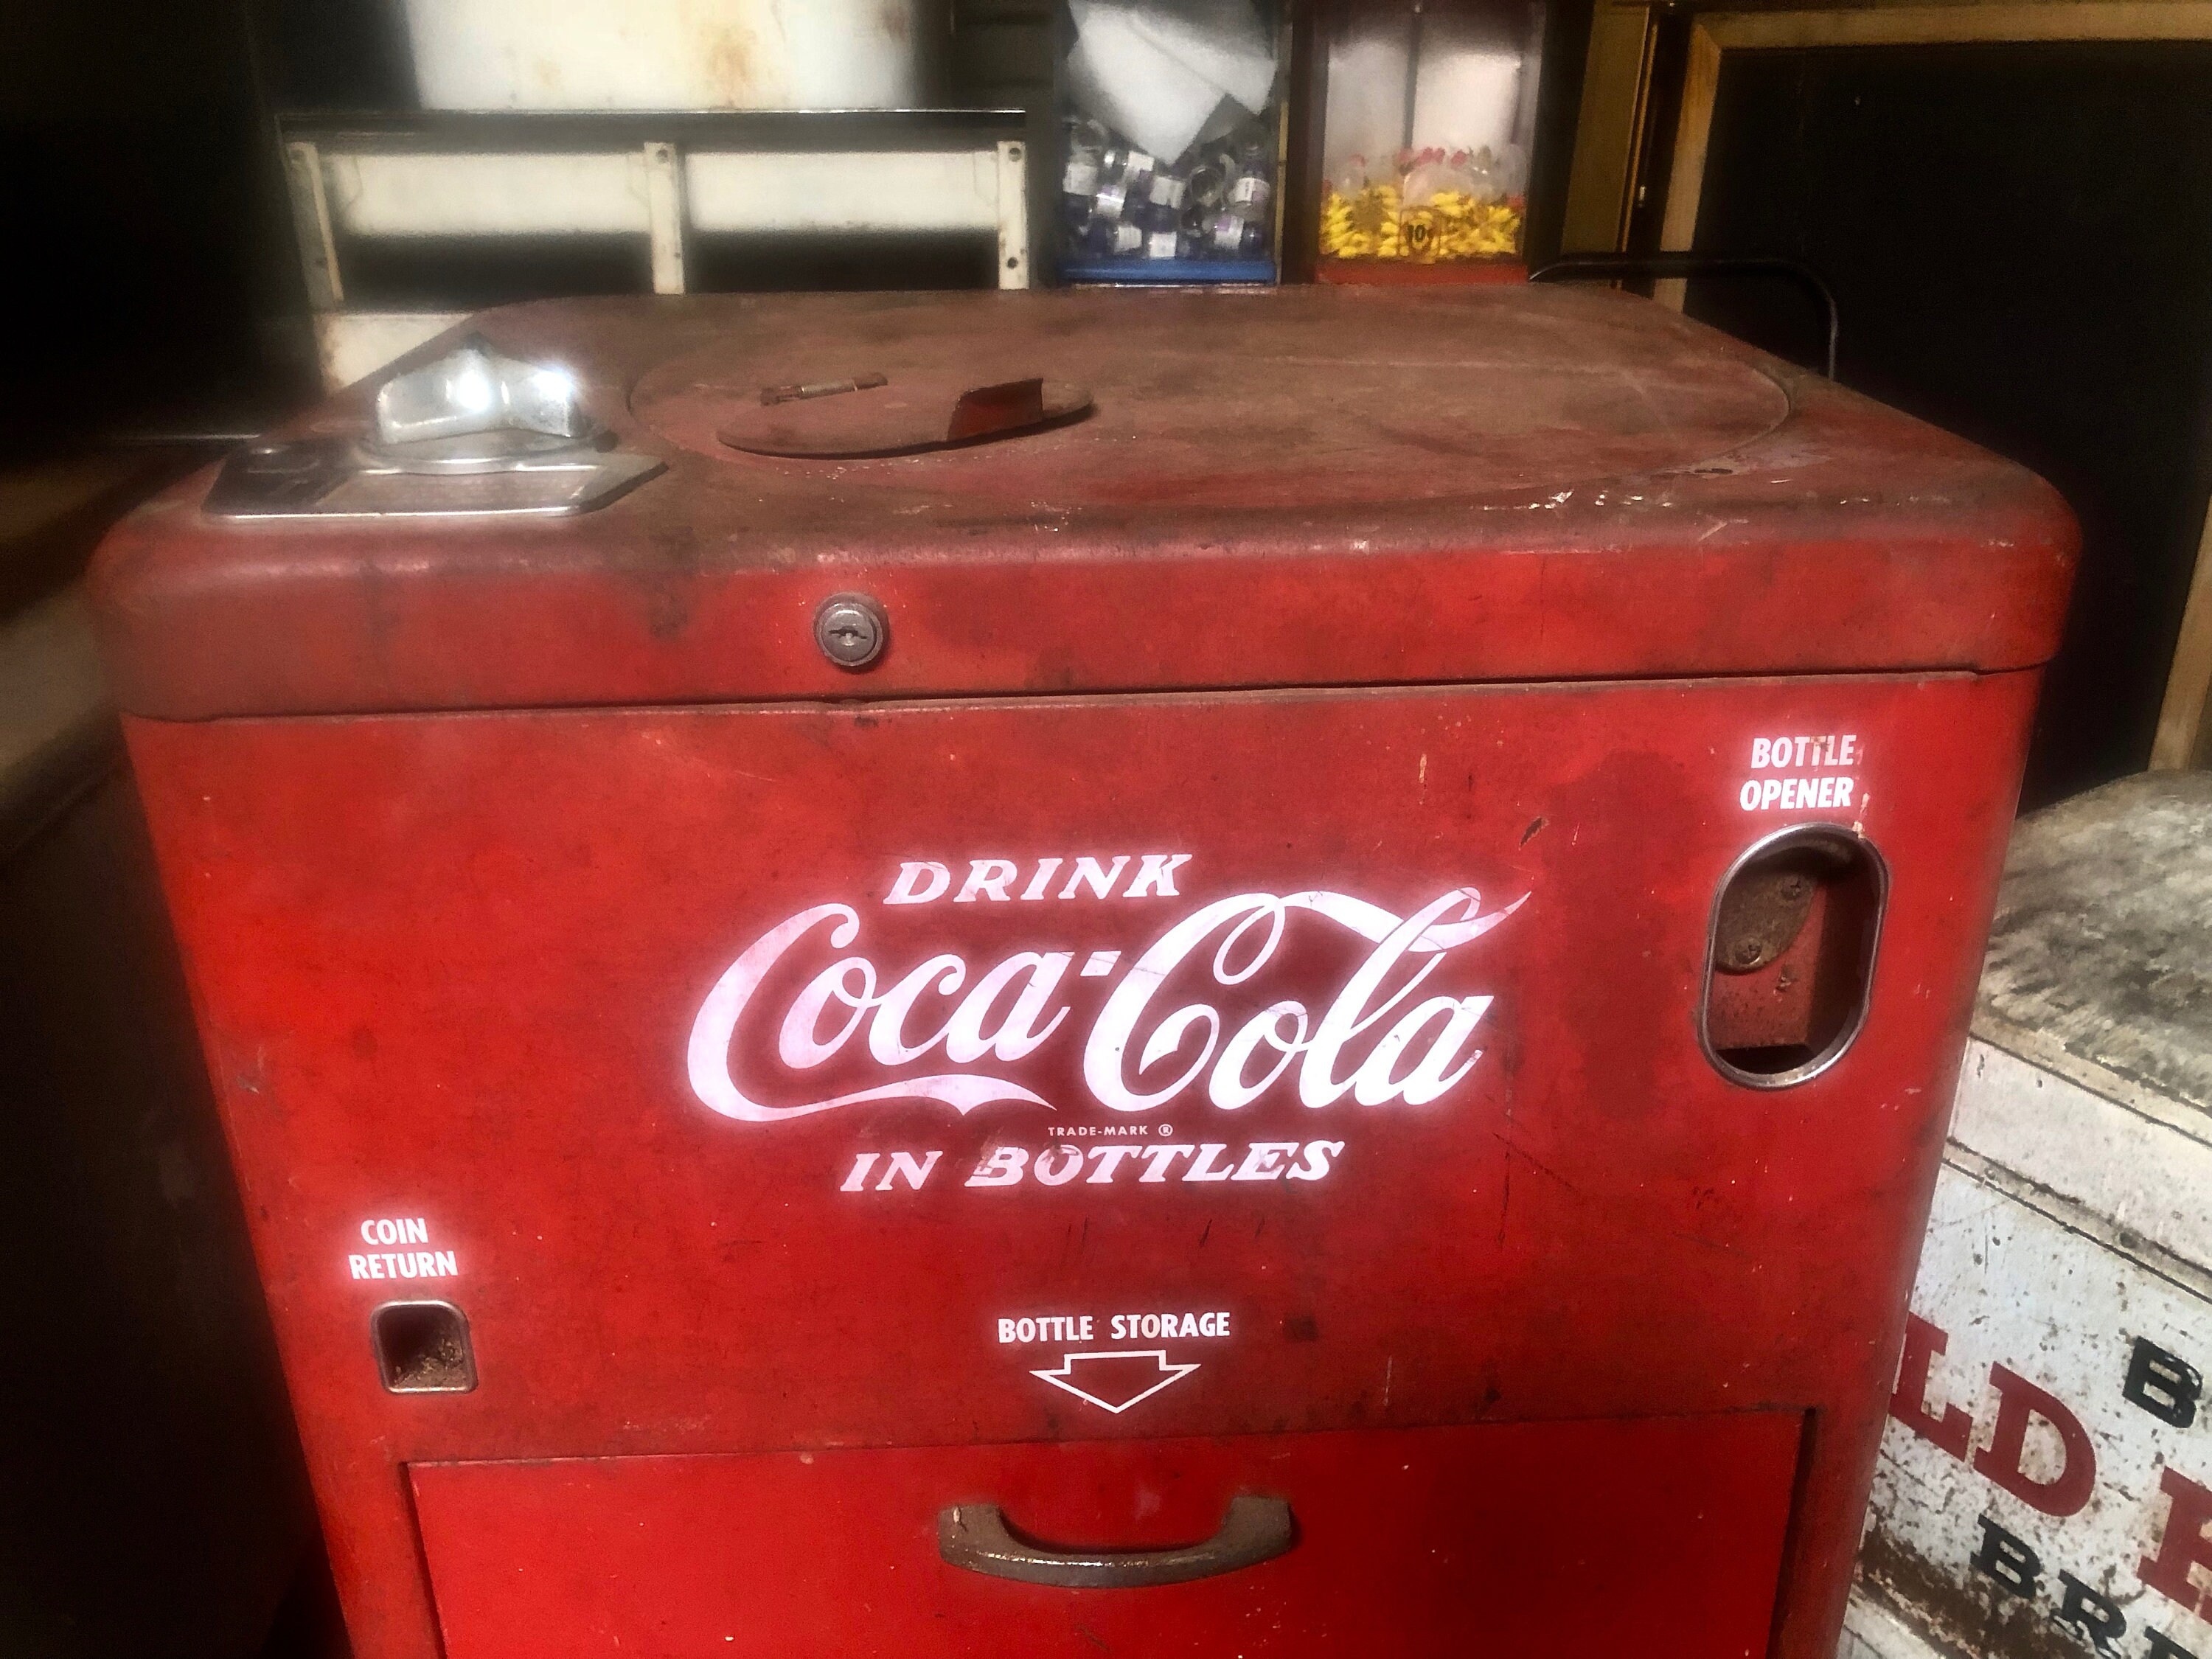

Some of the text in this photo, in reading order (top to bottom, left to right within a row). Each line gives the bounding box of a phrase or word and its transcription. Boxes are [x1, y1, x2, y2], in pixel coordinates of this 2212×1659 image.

[1750, 734, 1857, 769] BOTTLE
[1739, 776, 1854, 811] OPENER
[883, 853, 1193, 905] DRINK
[686, 887, 1532, 1123] Coca-Cola
[1047, 1125, 1149, 1137] TRADE-MARK
[839, 1140, 1346, 1192] IN BOTTLES
[361, 1218, 428, 1245] COIN
[348, 1251, 459, 1279] RETURN
[998, 1312, 1230, 1343] BOTTLE STORAGE
